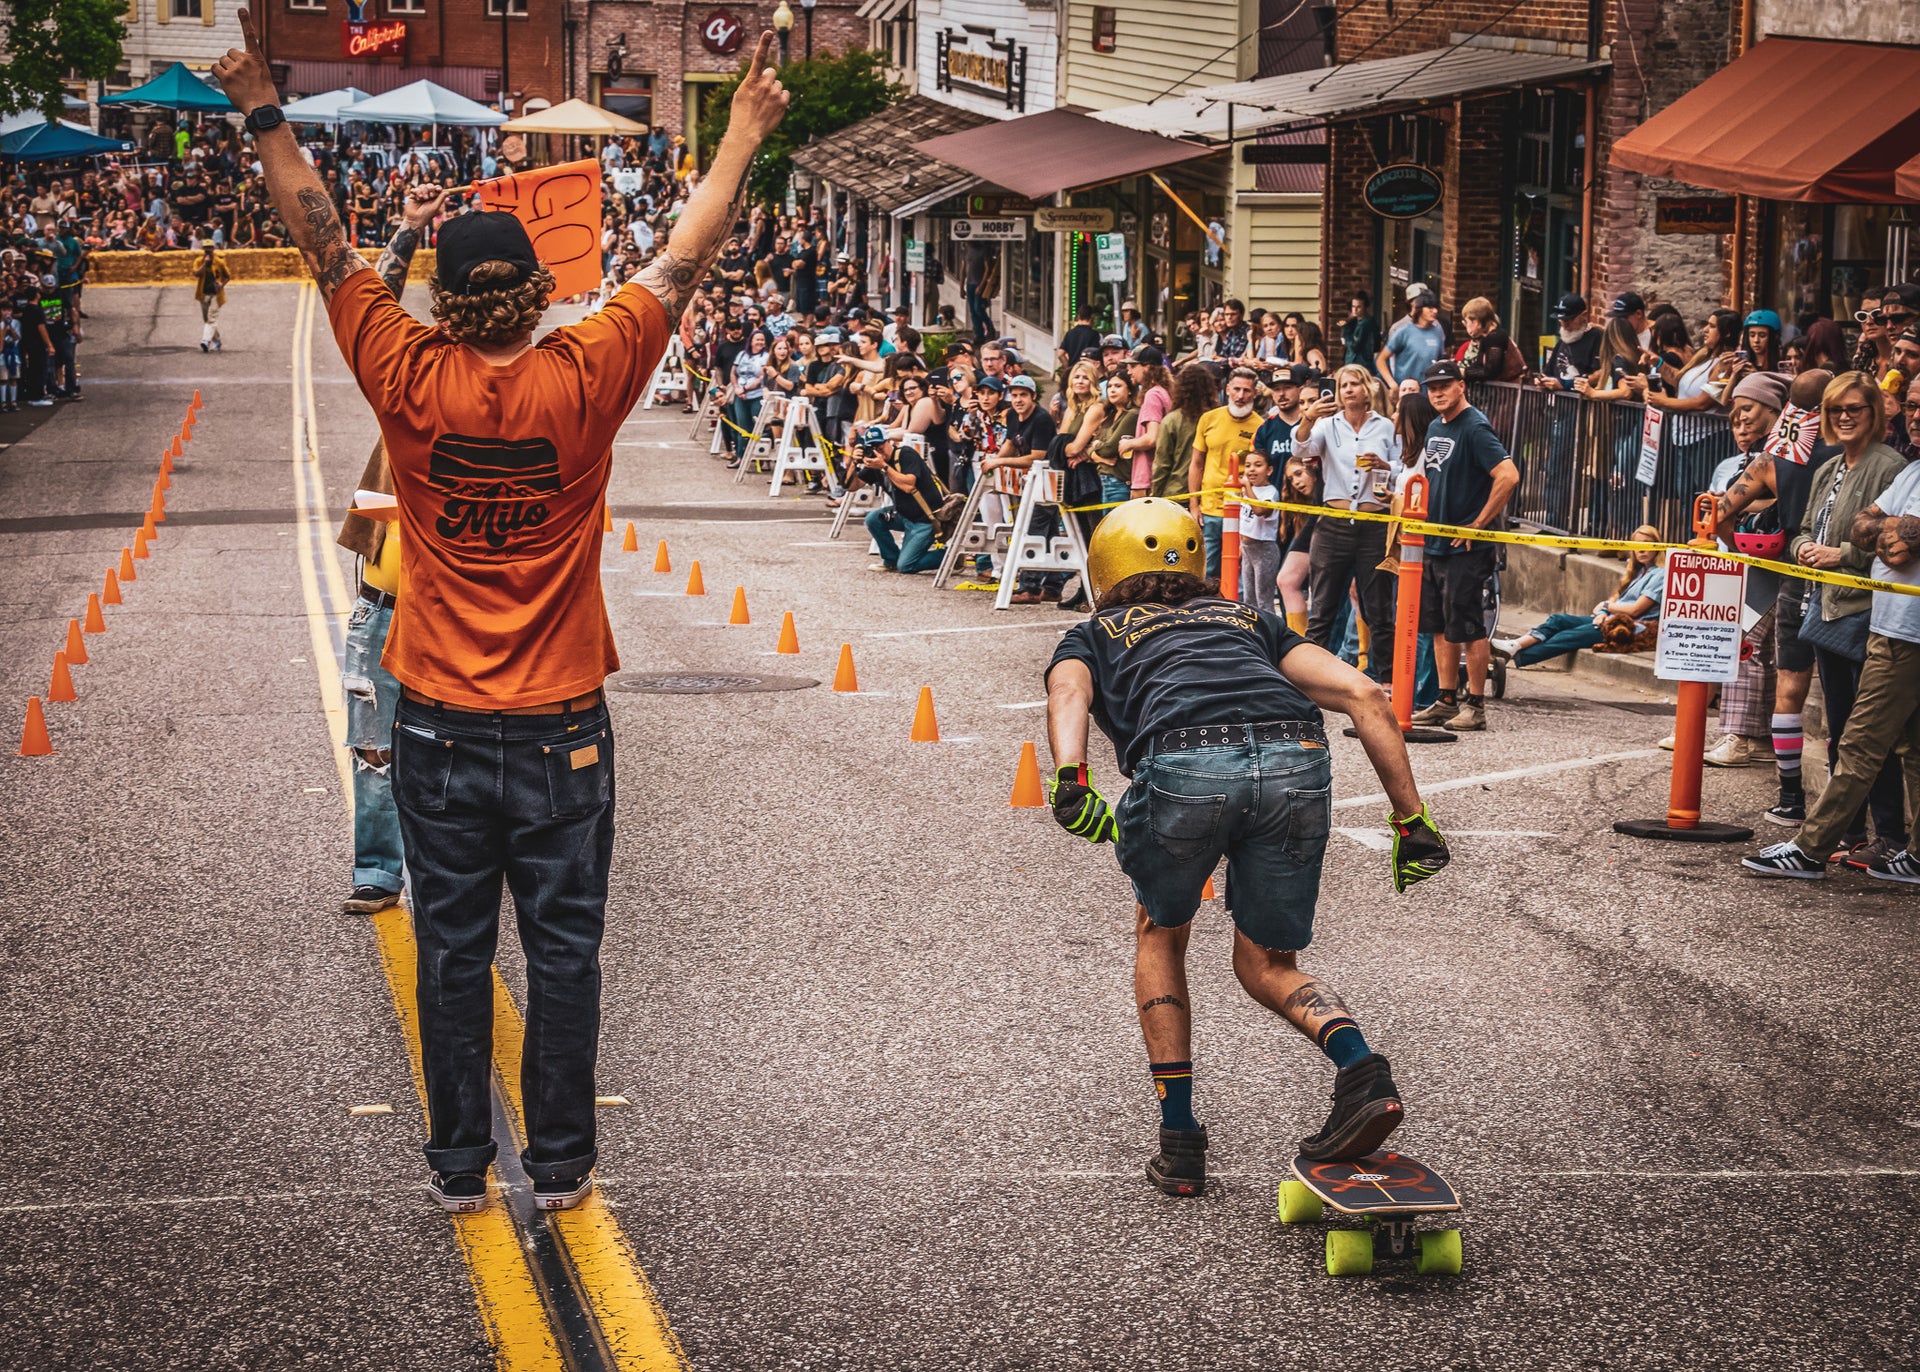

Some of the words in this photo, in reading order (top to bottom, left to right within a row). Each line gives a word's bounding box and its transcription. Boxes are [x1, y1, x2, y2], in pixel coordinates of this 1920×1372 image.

[350, 21, 406, 55] California
[527, 173, 595, 265] GO
[982, 222, 1016, 233] HOBBY
[1101, 237, 1108, 249] 3
[1778, 418, 1801, 442] 56
[1271, 439, 1292, 454] Ast
[436, 500, 551, 548] Milo
[1674, 554, 1739, 572] TEMPORARY
[1671, 572, 1700, 598] NO
[1667, 602, 1737, 622] PARKING
[1691, 643, 1719, 652] Parking
